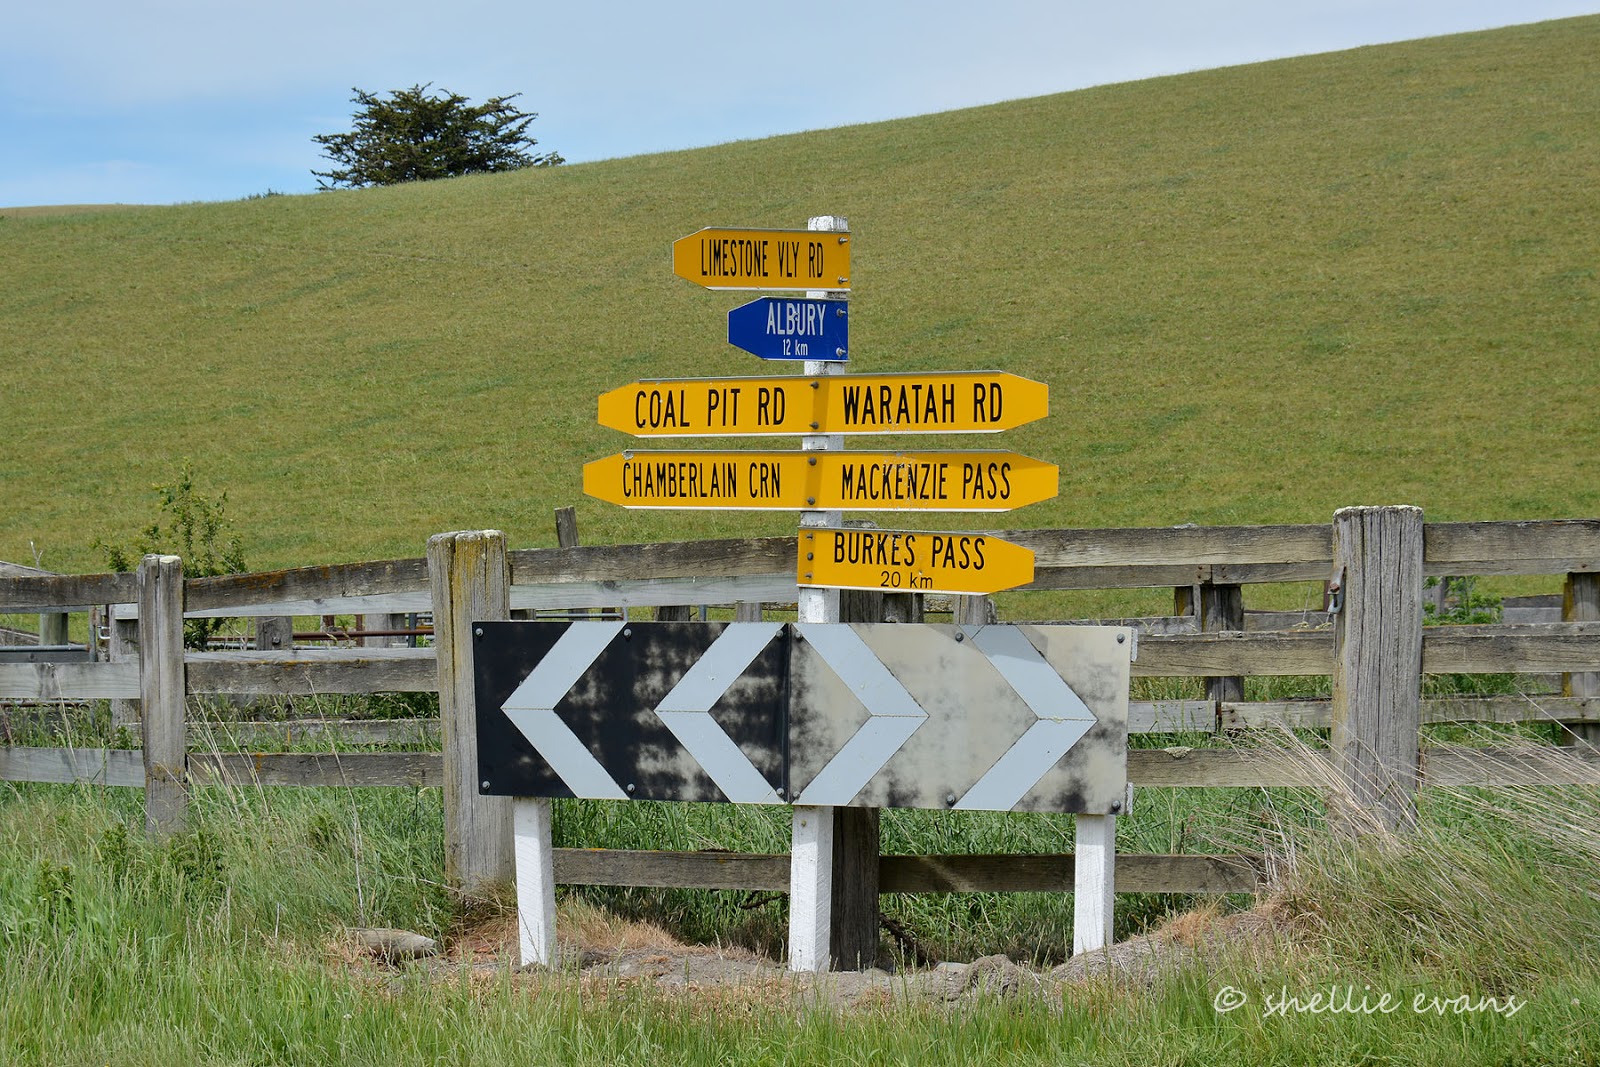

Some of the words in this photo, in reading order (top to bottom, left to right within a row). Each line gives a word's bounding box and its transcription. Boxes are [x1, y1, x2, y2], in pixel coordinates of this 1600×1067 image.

[701, 238, 769, 277] LIMESTONE
[777, 241, 800, 278] VLY
[808, 242, 824, 278] RD
[766, 302, 826, 336] ALBURY
[782, 338, 791, 356] 12
[794, 339, 808, 356] km
[635, 389, 690, 429] COAL
[707, 388, 741, 427] PIT
[757, 387, 785, 426] RD
[843, 383, 955, 425] WARATAH
[973, 382, 1003, 423] RD
[622, 462, 737, 498] CHAMBERLAIN
[749, 462, 781, 499] CRN
[841, 463, 948, 500] MACKENZIE
[962, 462, 1012, 500] PASS
[834, 532, 916, 567] BURKES
[931, 535, 986, 571] PASS
[880, 570, 901, 588] 20
[909, 572, 933, 589] km
